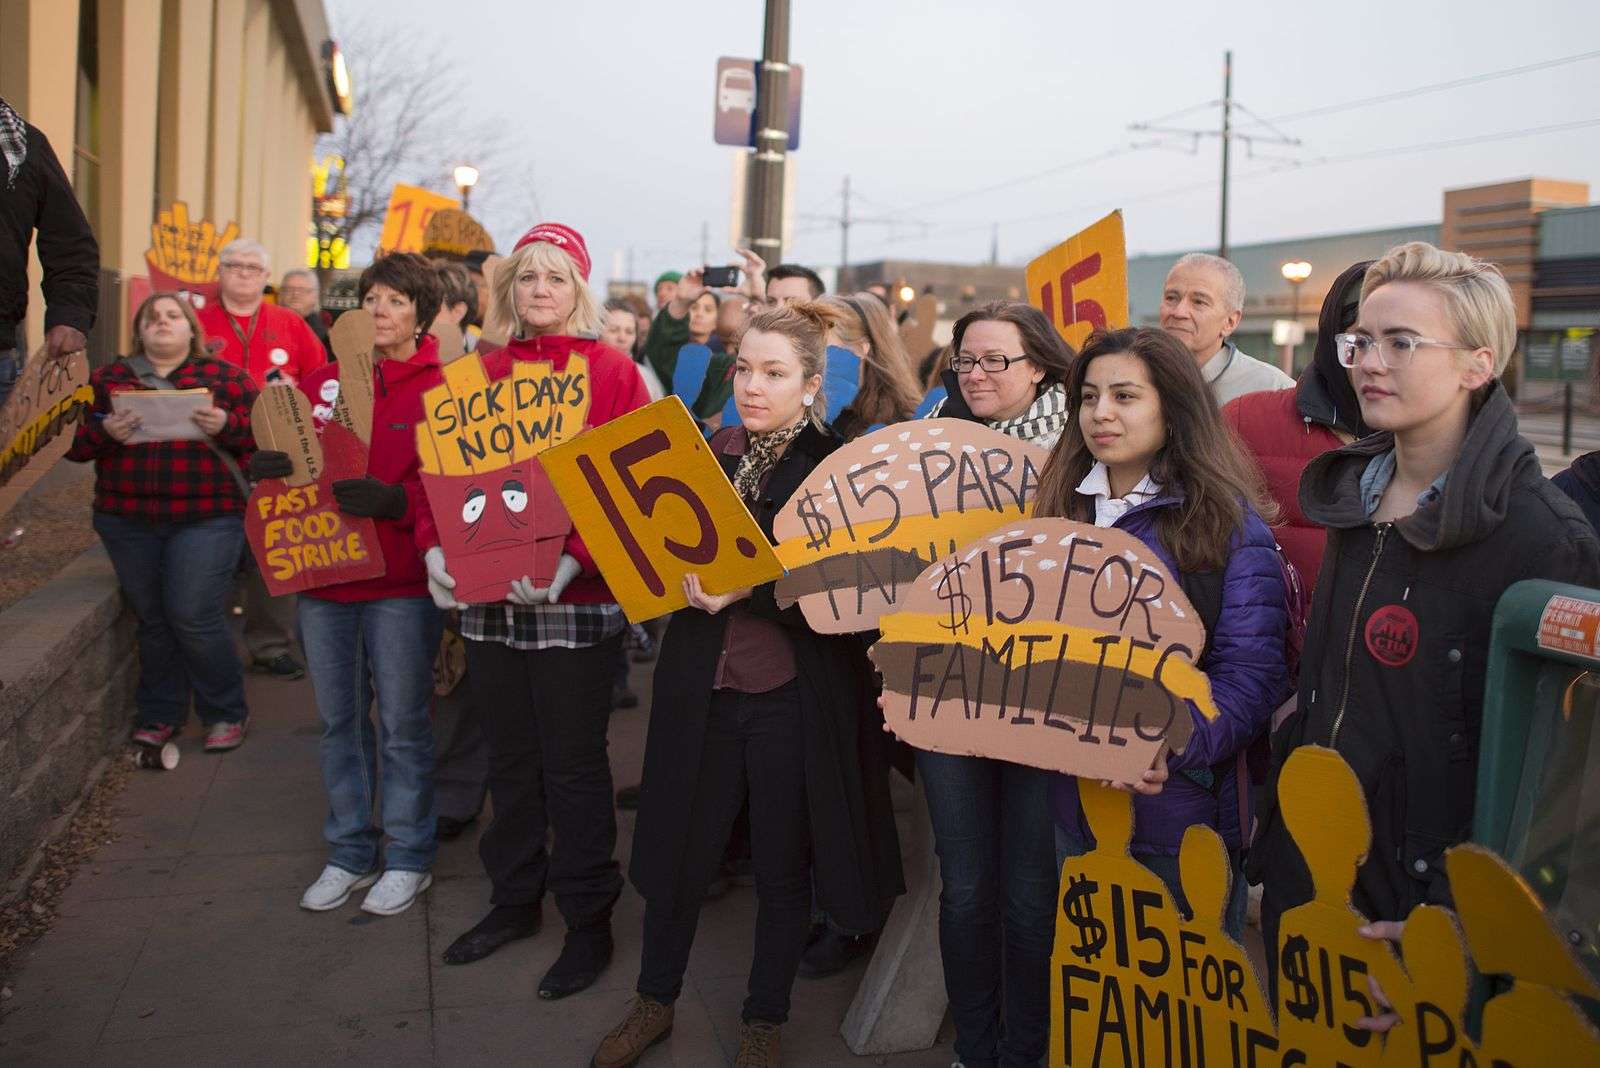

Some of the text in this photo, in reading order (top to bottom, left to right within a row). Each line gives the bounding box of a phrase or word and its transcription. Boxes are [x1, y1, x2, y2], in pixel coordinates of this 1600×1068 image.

[1041, 250, 1107, 342] 15
[286, 385, 302, 424] embled
[301, 438, 310, 455] the
[434, 374, 585, 436] SICK DAYS
[456, 412, 564, 466] NOW!
[257, 484, 319, 520] FAST
[265, 511, 341, 549] FOOD
[575, 429, 757, 598] 15.
[796, 448, 1041, 551] $15 PARA
[266, 532, 368, 581] STRIKE
[937, 537, 1165, 643] $15 FOR
[908, 633, 1194, 747] FAMILIES
[1063, 873, 1249, 1013] $15 FOR
[1281, 934, 1372, 1048] $15
